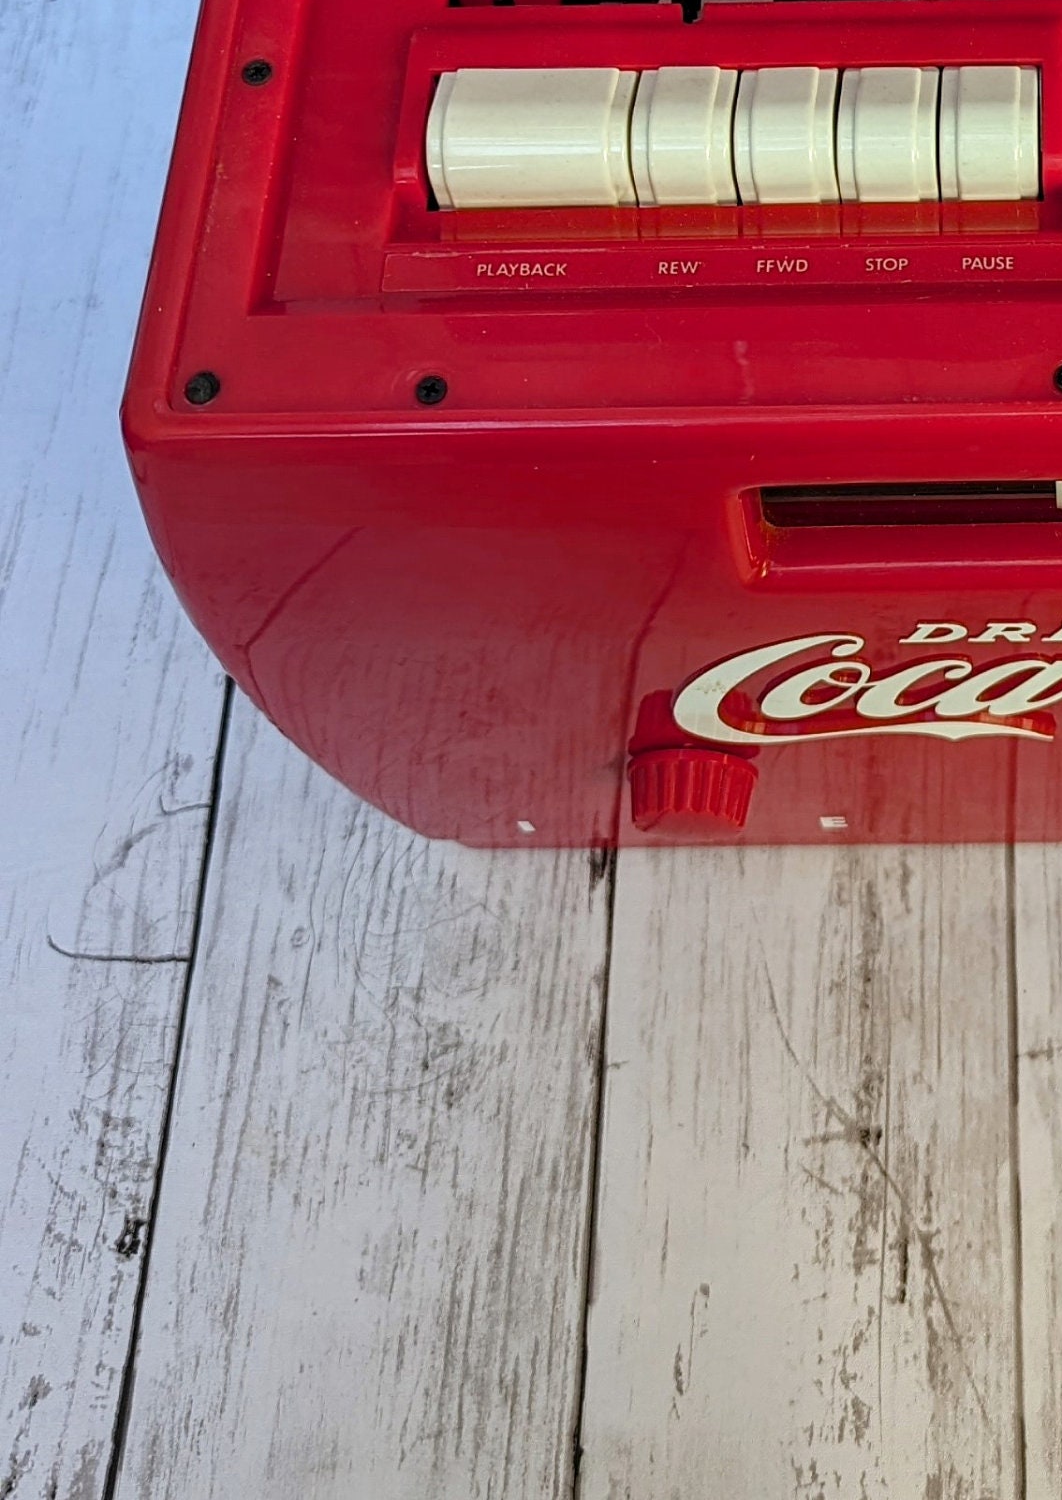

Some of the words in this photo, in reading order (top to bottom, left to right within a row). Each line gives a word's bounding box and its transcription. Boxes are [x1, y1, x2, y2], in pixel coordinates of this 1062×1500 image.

[476, 262, 568, 277] PLAYBACK
[657, 260, 698, 275] REW
[756, 259, 809, 274] FFWD
[865, 257, 909, 272] STOP
[961, 256, 1014, 271] PAUSE
